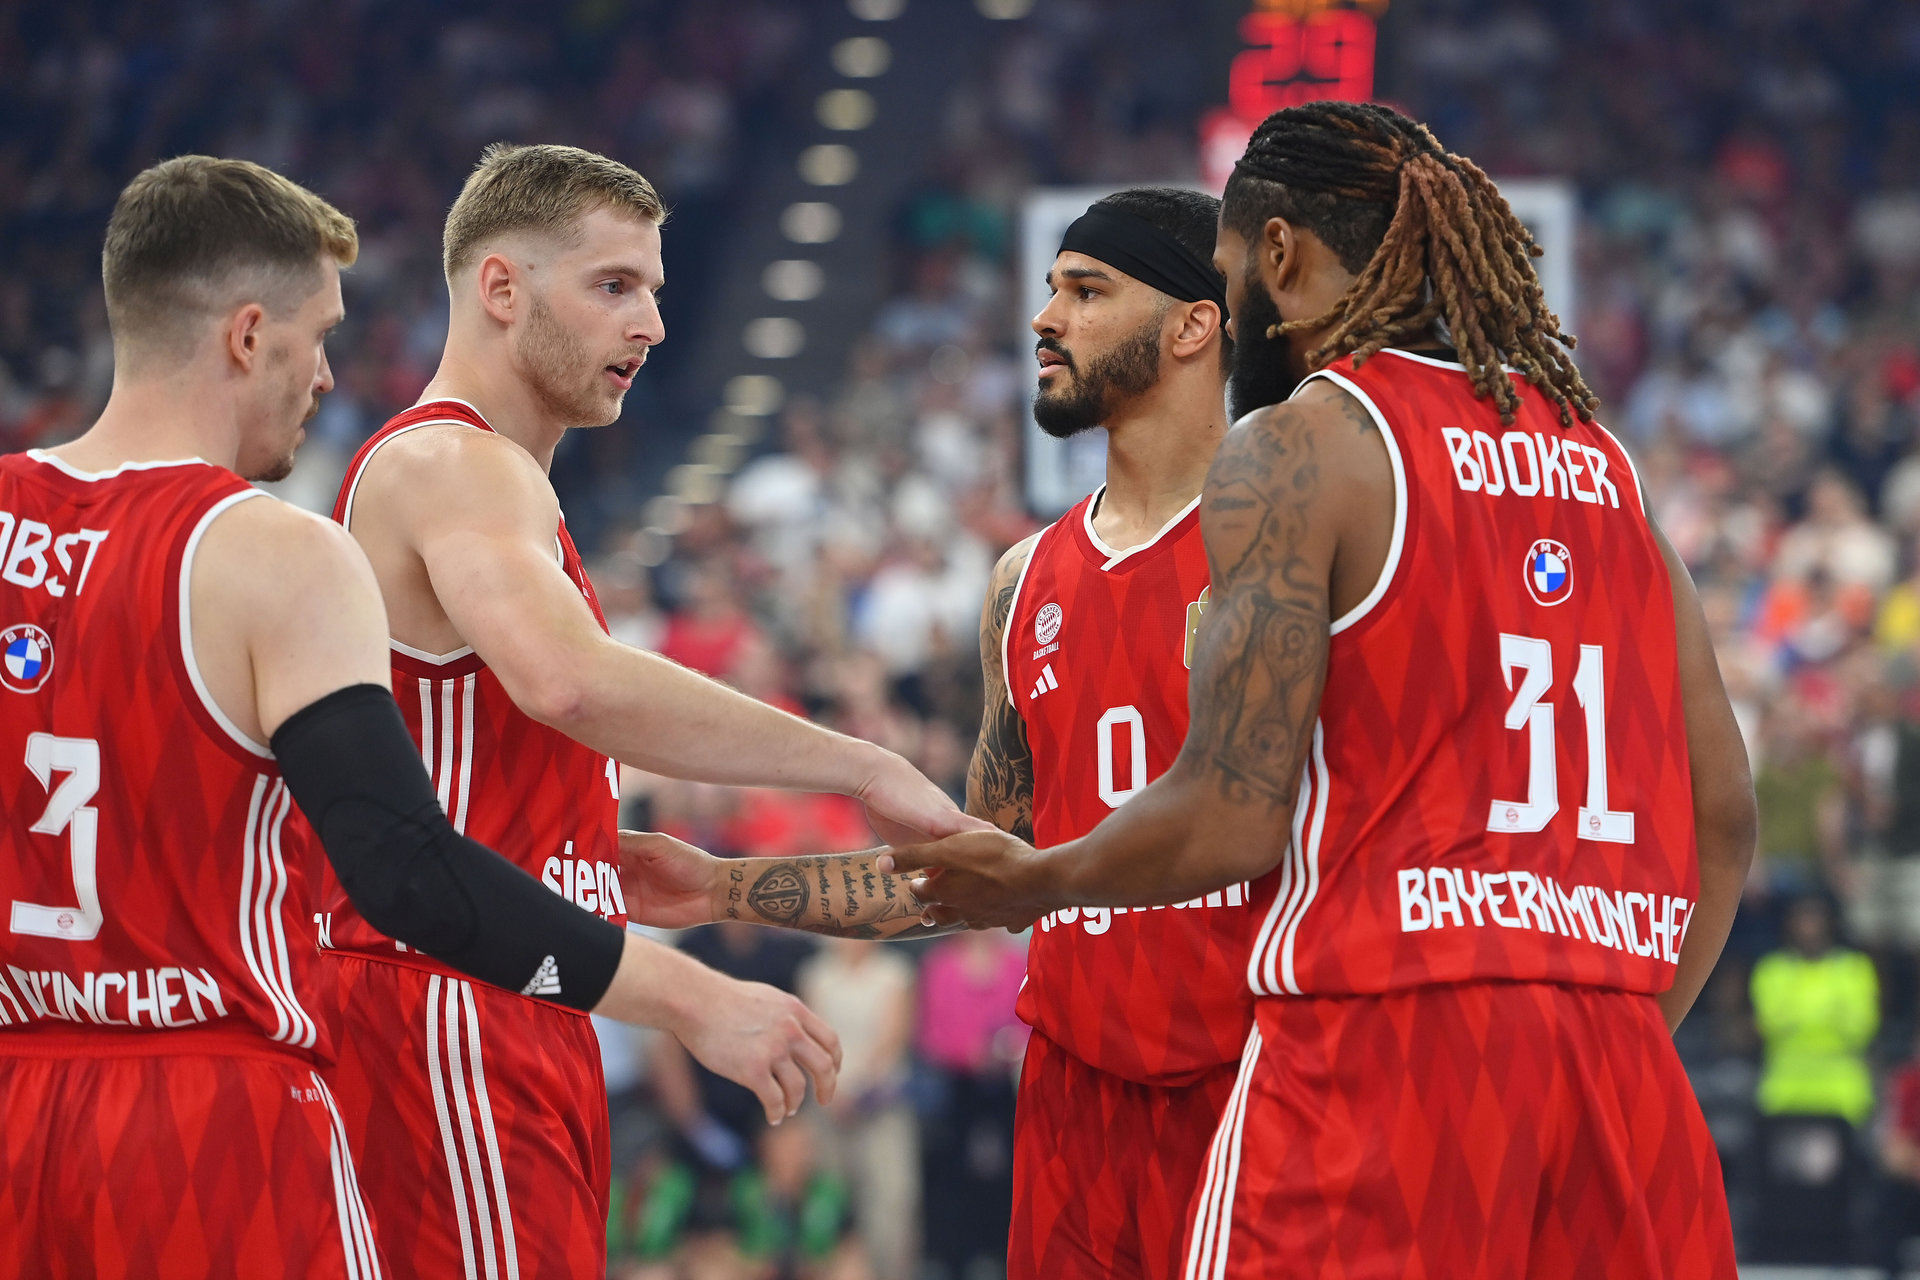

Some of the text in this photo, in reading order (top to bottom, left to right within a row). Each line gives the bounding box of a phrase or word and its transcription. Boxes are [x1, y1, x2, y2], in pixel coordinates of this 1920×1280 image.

[1441, 427, 1620, 509] BOOKER
[0, 510, 109, 597] BST
[1531, 543, 1568, 560] BMW
[4, 628, 50, 650] BMW
[1033, 641, 1060, 660] BASKETBALL
[1097, 704, 1147, 808] 0
[1486, 632, 1635, 845] 31
[10, 731, 104, 941] 3
[1556, 882, 1695, 965] MÜNCHE
